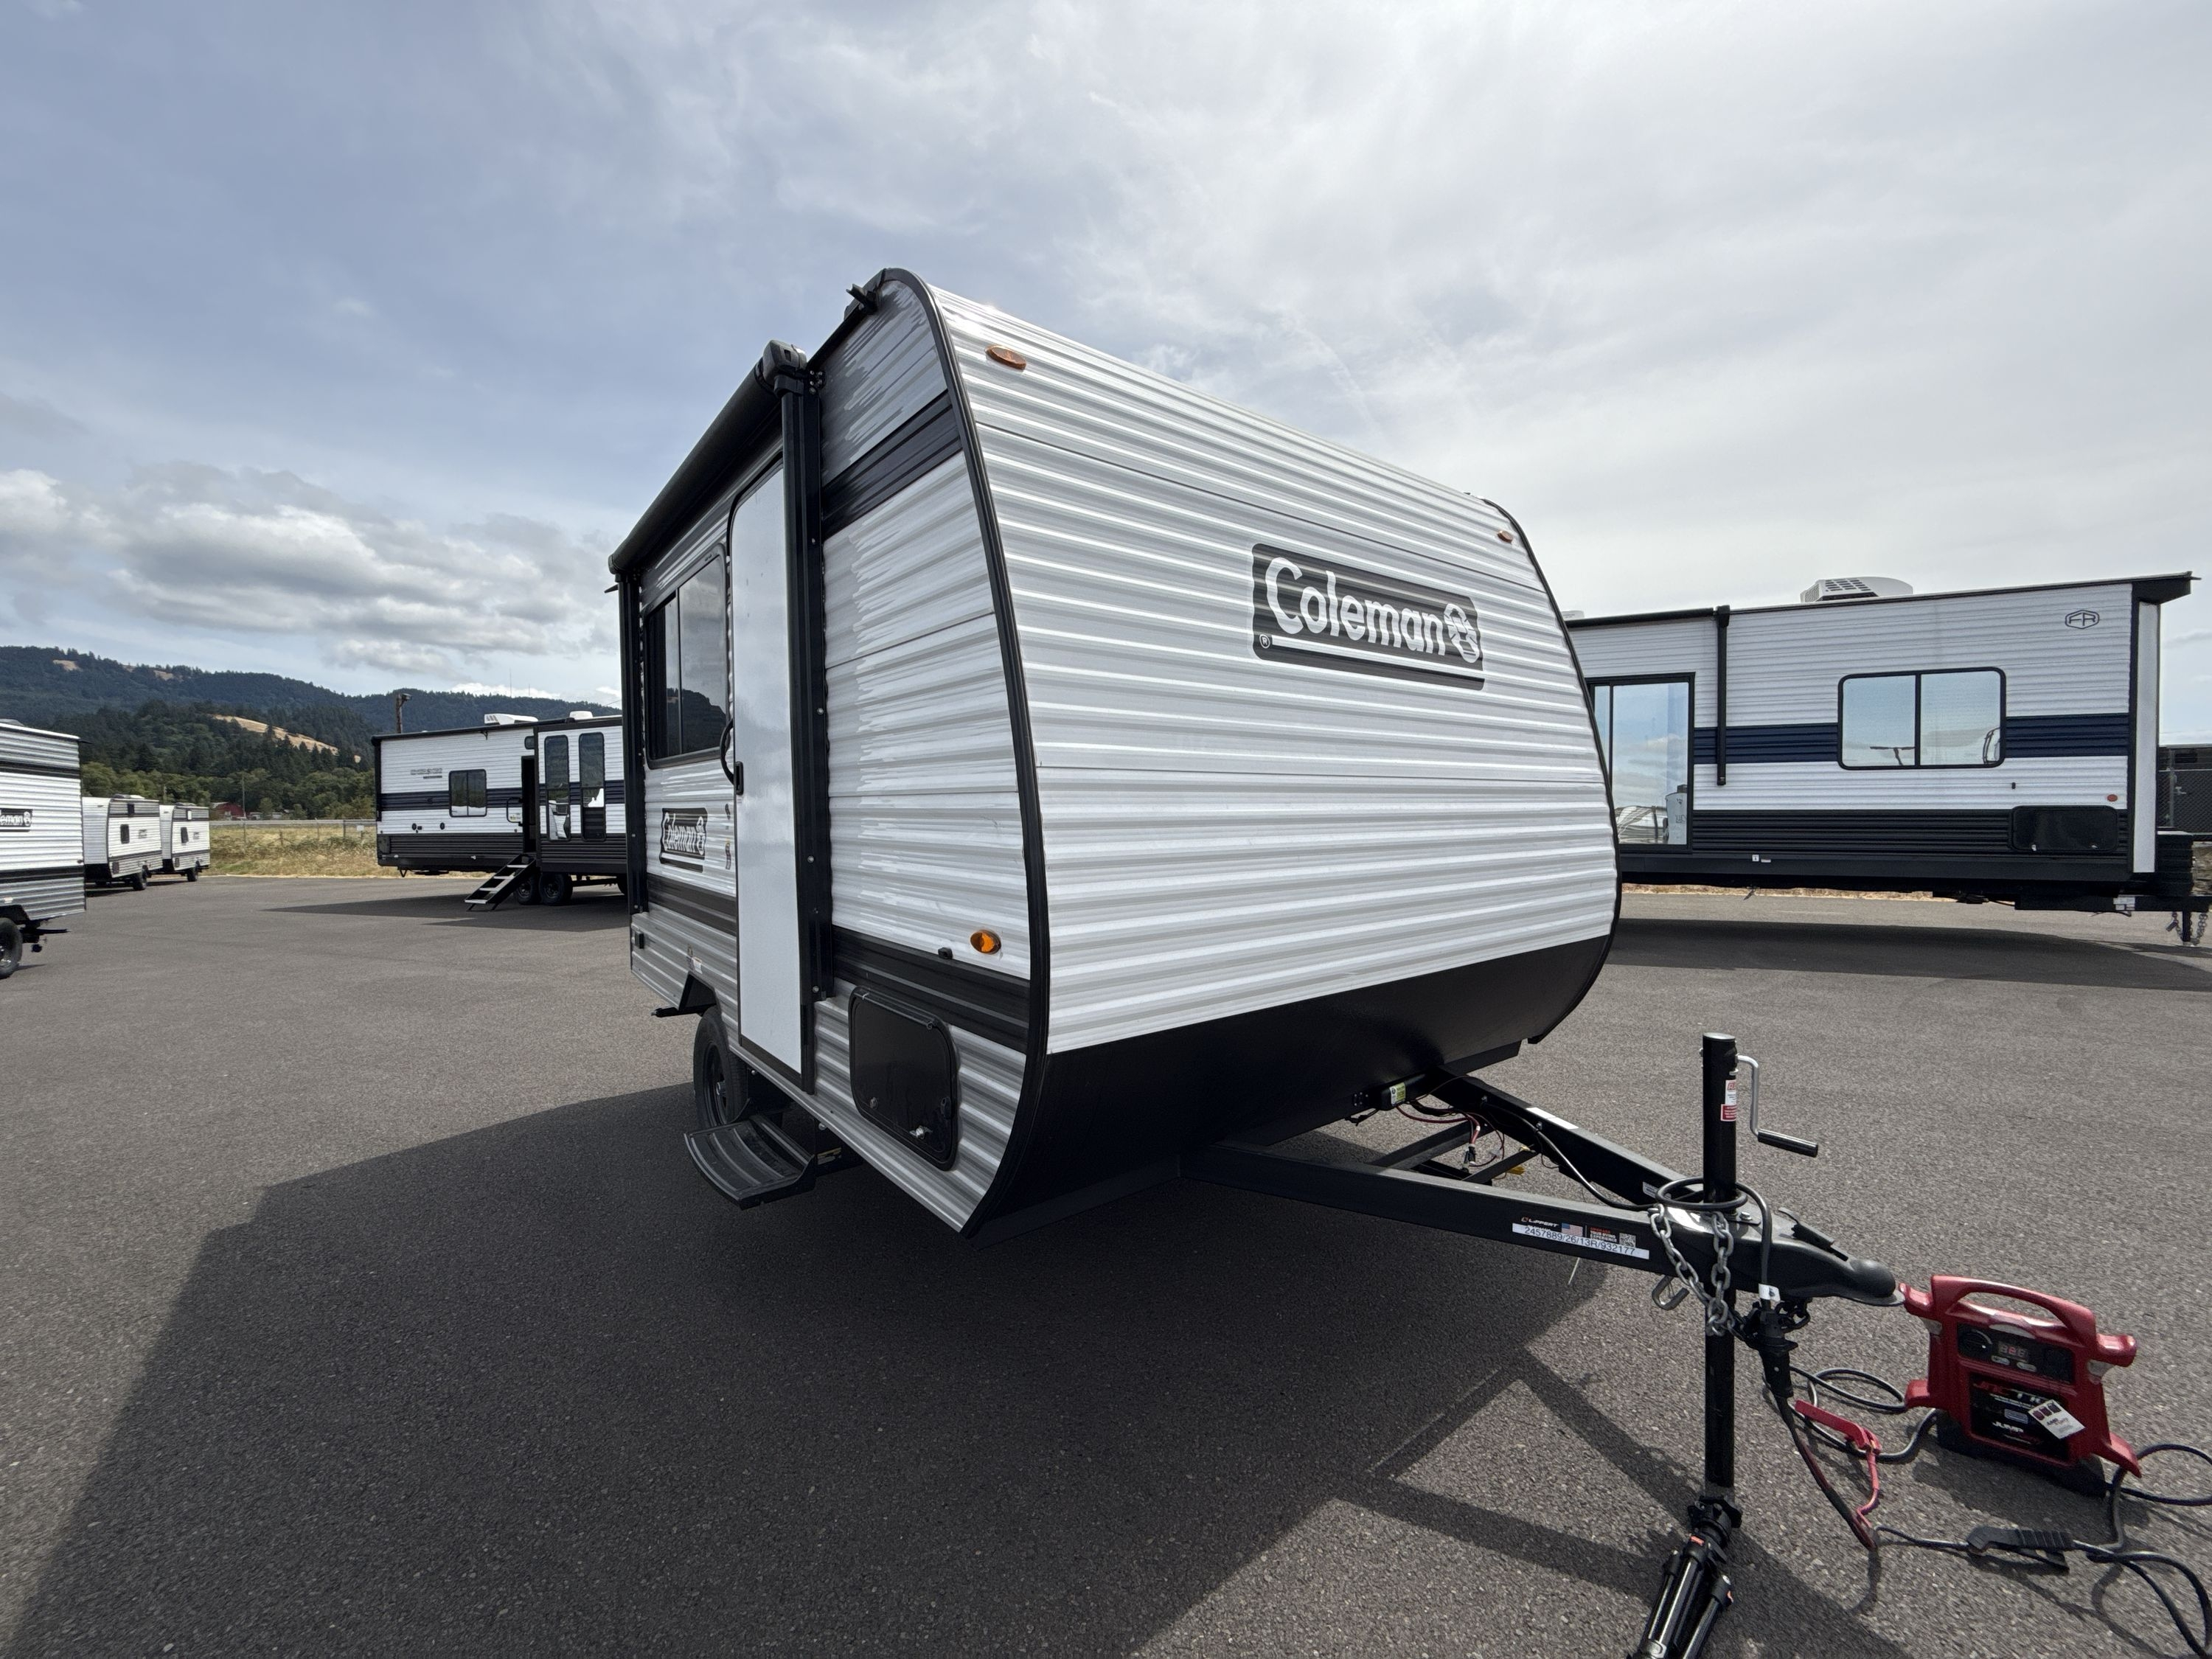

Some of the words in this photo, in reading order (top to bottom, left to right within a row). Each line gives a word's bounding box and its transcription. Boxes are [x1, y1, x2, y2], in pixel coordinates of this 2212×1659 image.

[1265, 557, 1446, 656] Coleman
[662, 812, 696, 853] Coleman
[1524, 1226, 1635, 1255] 2457889/26/13R/932177
